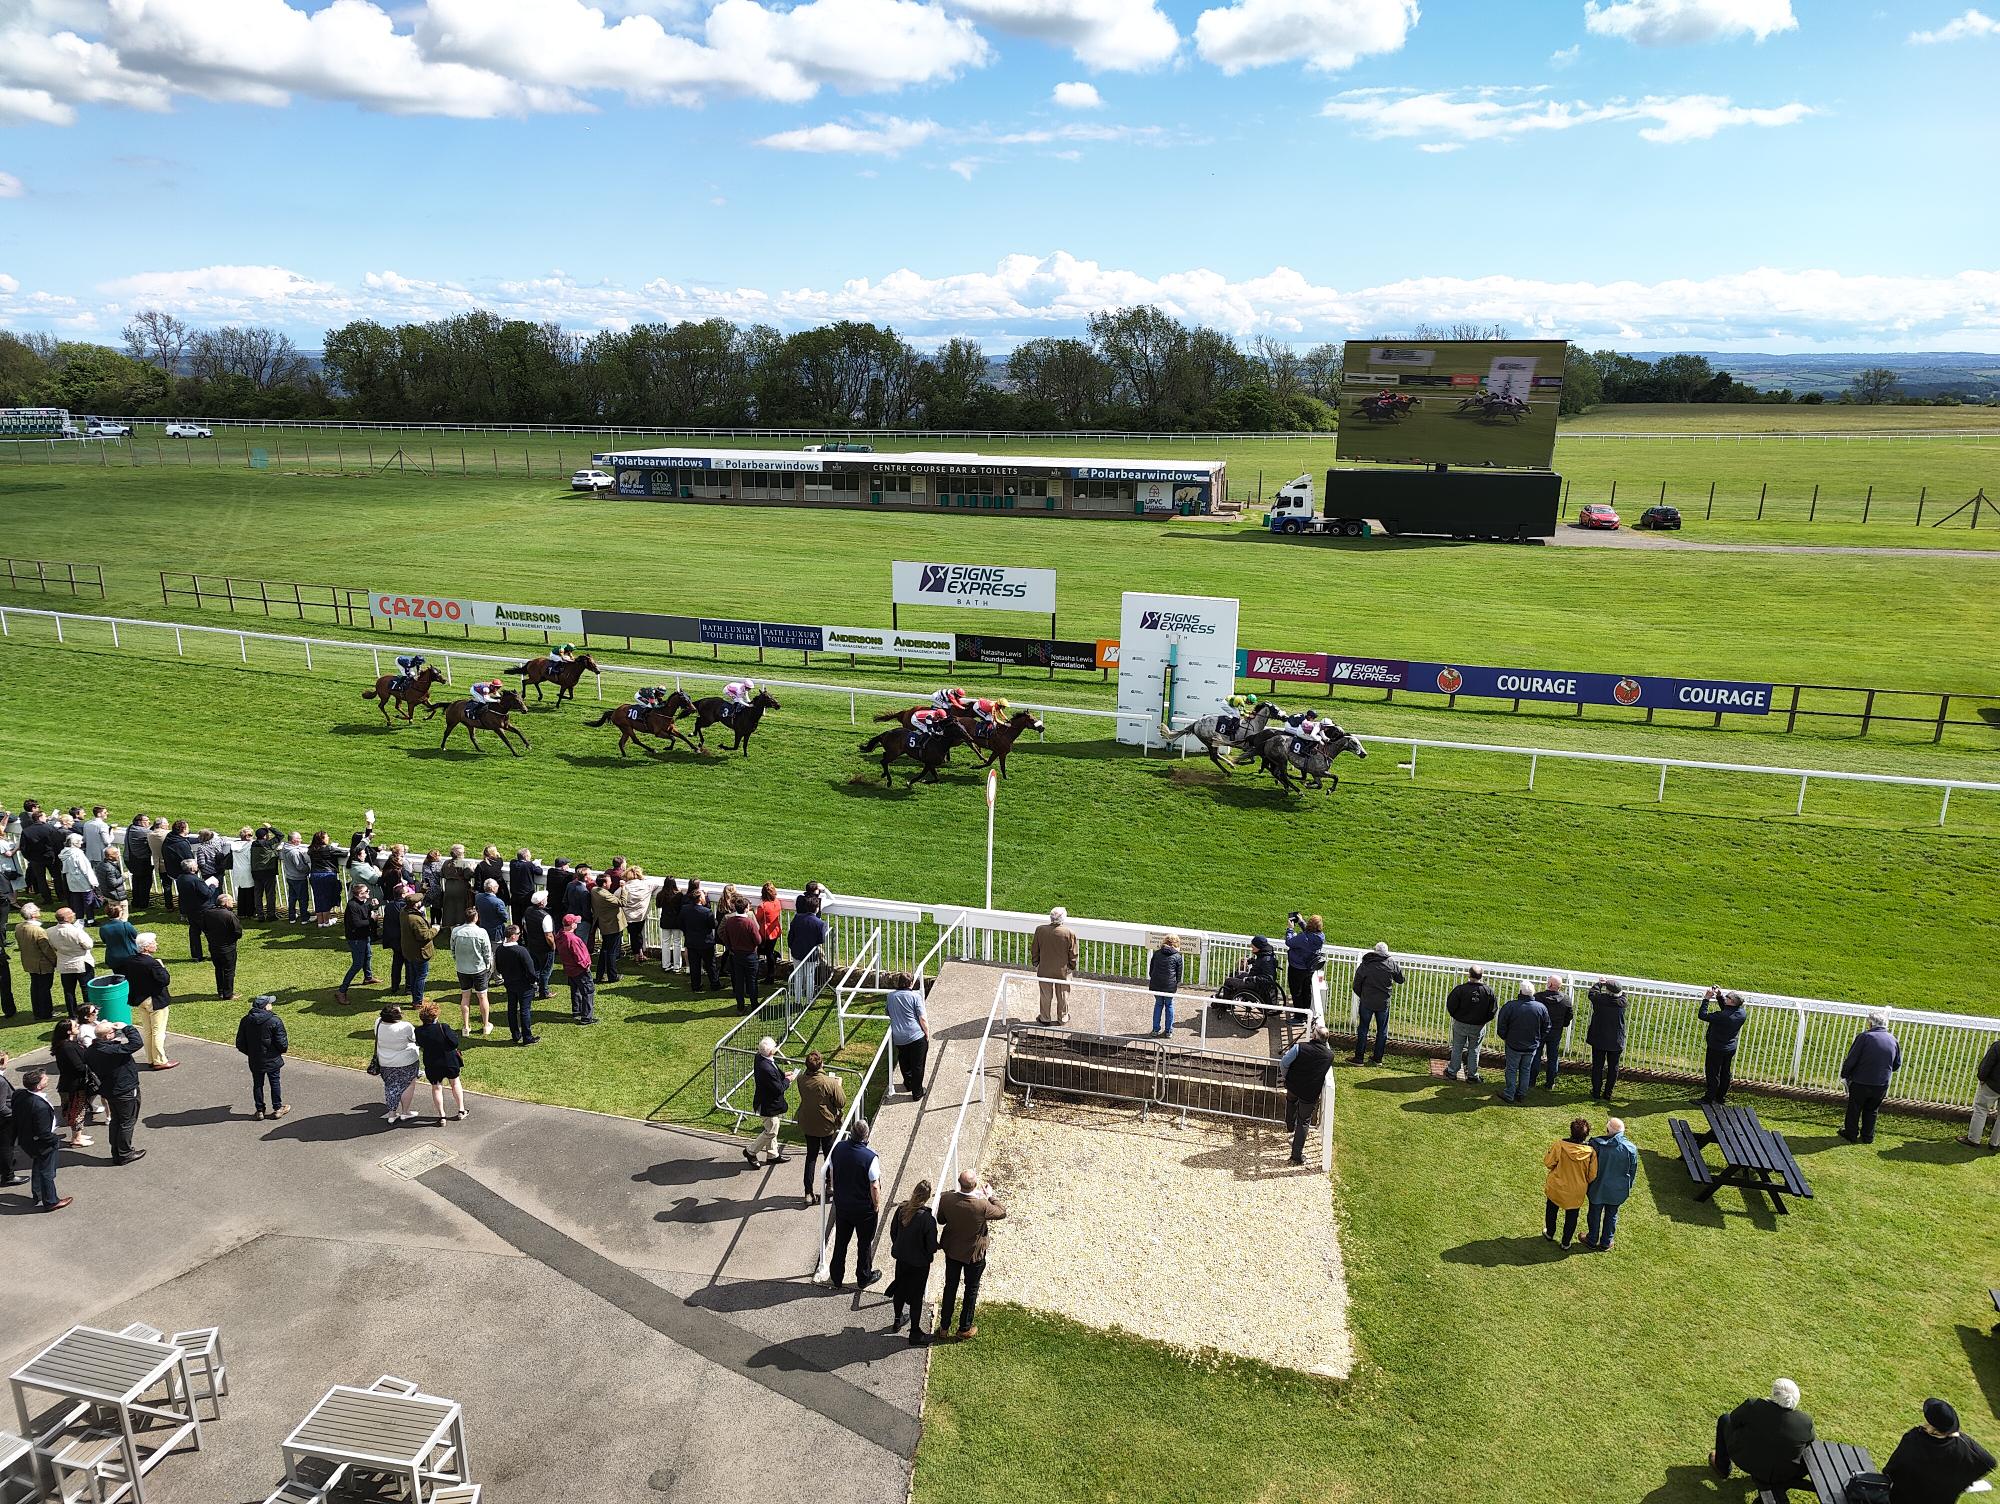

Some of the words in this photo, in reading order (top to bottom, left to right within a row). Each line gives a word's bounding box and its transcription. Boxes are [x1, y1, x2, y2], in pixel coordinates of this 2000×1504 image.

[612, 456, 703, 467] Polarbearwindows
[725, 459, 820, 471] Polarbearwindows
[873, 464, 907, 472] CENTRE
[911, 465, 946, 473] COURSE
[950, 466, 967, 474] BAR
[971, 466, 977, 474] &
[981, 467, 1018, 475] TOILETS
[1091, 468, 1198, 481] Polarbearwindows
[950, 567, 1005, 582] SIGNS
[947, 581, 1027, 598] EXPRESS
[379, 596, 461, 620] CAZOO
[495, 605, 561, 623] ANDERSONS
[1162, 612, 1201, 623] SIGNS
[702, 624, 723, 632] BATH
[725, 626, 758, 635] LUXURY
[763, 628, 784, 637] BATH
[787, 630, 820, 639] LUXURY
[1160, 622, 1216, 634] EXPRESS
[705, 632, 733, 640] TOILET
[766, 635, 795, 644] TOILET
[798, 638, 818, 646] HIRE
[828, 631, 883, 645] ANDERSONS
[893, 636, 951, 650] ANDERSONS
[1273, 658, 1308, 669] SIGNS
[1353, 664, 1388, 674] SIGNS
[1270, 667, 1320, 677] EXPRESS
[1350, 672, 1401, 683] EXPRESS
[391, 680, 398, 690] 7
[1497, 675, 1577, 695] COURAGE
[1679, 686, 1766, 707] COURAGE
[627, 708, 638, 720] 10
[722, 708, 729, 718] 3
[1219, 723, 1226, 734] 8
[909, 736, 916, 748] 5
[1293, 742, 1301, 754] 9
